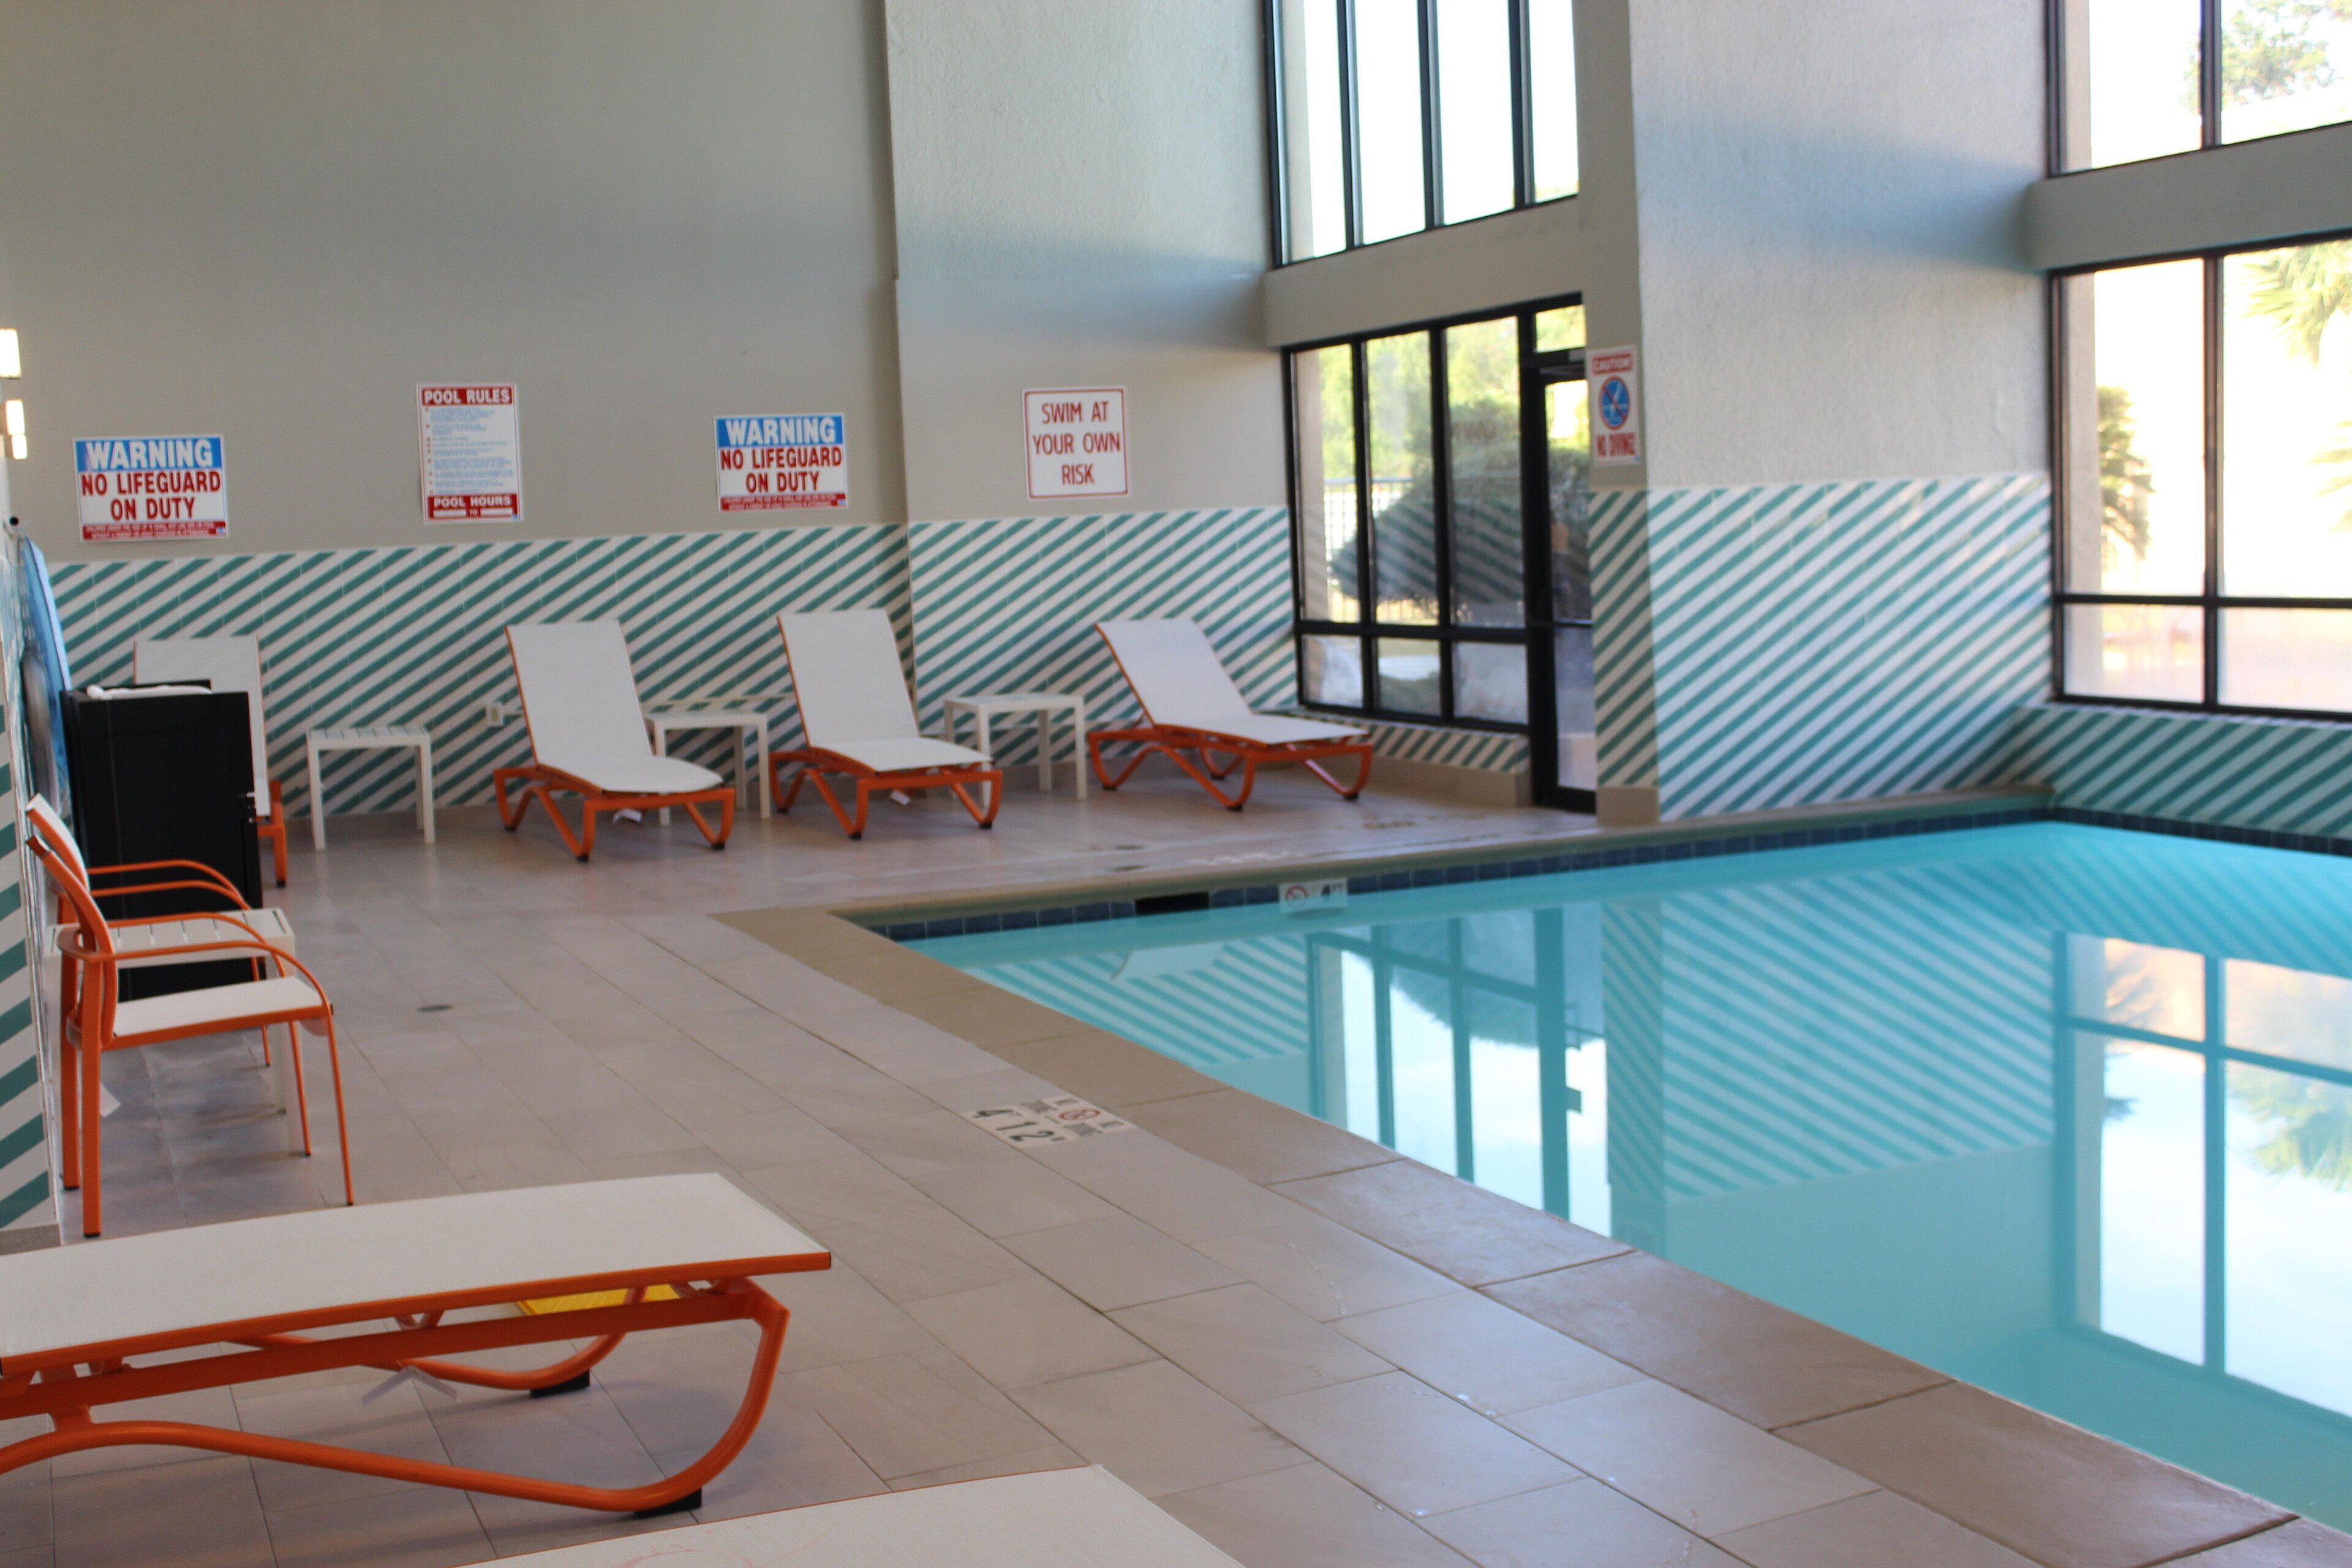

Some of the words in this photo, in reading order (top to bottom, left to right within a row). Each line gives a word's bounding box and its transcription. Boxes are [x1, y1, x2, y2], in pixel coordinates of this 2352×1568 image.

[424, 390, 461, 404] POOL
[466, 389, 510, 404] RULES
[1041, 402, 1082, 424] SWIM
[1091, 401, 1108, 422] AT
[725, 417, 835, 445] WARNING
[85, 439, 213, 470] WARNING
[1033, 433, 1073, 455] YOUR
[1083, 432, 1120, 453] OWN
[720, 449, 744, 470] NO
[752, 447, 842, 469] LIFEGUARD
[81, 473, 107, 496] NO
[117, 471, 221, 494] LIFEGUARD
[745, 473, 768, 493] ON
[777, 471, 819, 492] DUTY
[1061, 464, 1095, 485] RISK
[110, 498, 137, 521] ON
[146, 497, 195, 519] DUTY
[434, 497, 465, 508] POOL
[470, 496, 511, 507] HOURS
